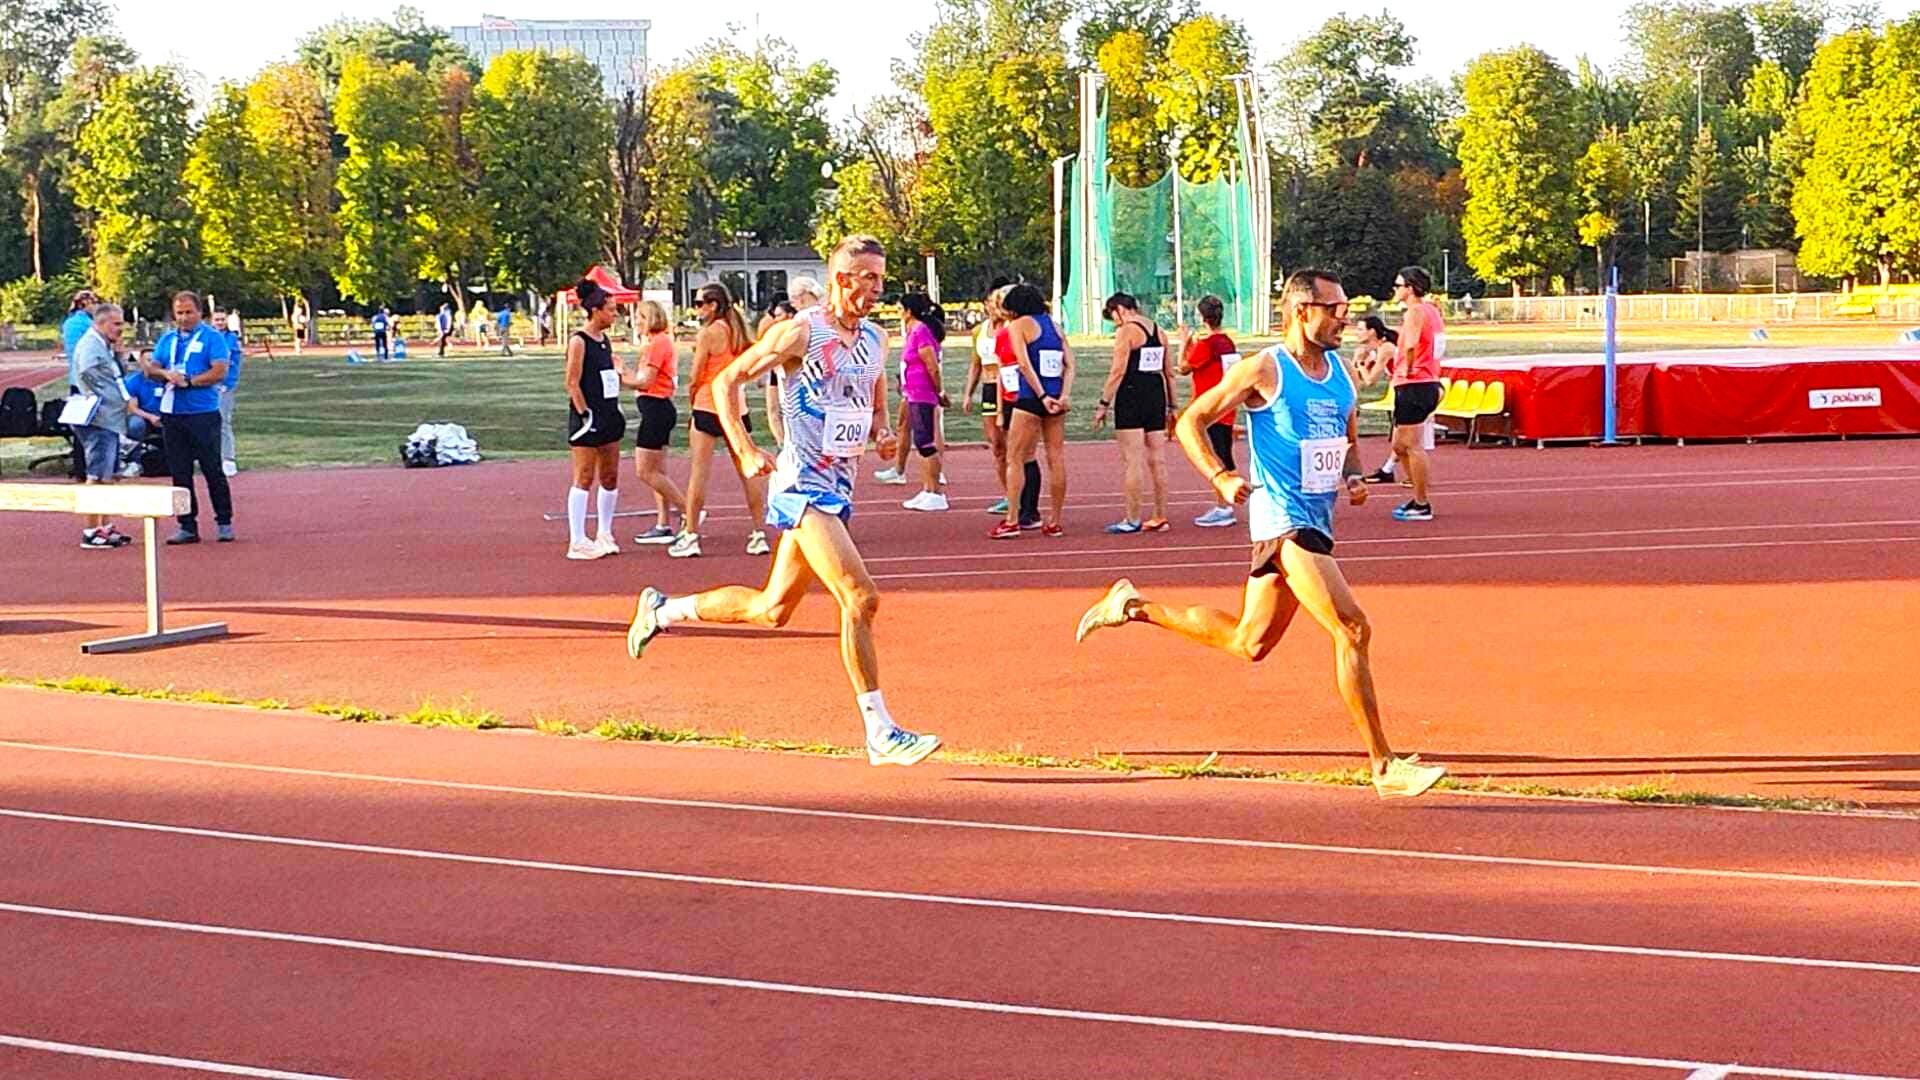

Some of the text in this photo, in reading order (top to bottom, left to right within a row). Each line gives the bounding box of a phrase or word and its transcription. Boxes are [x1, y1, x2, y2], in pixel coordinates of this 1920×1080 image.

[1831, 391, 1873, 405] polanik
[834, 423, 862, 442] 209
[1313, 449, 1341, 472] 308
